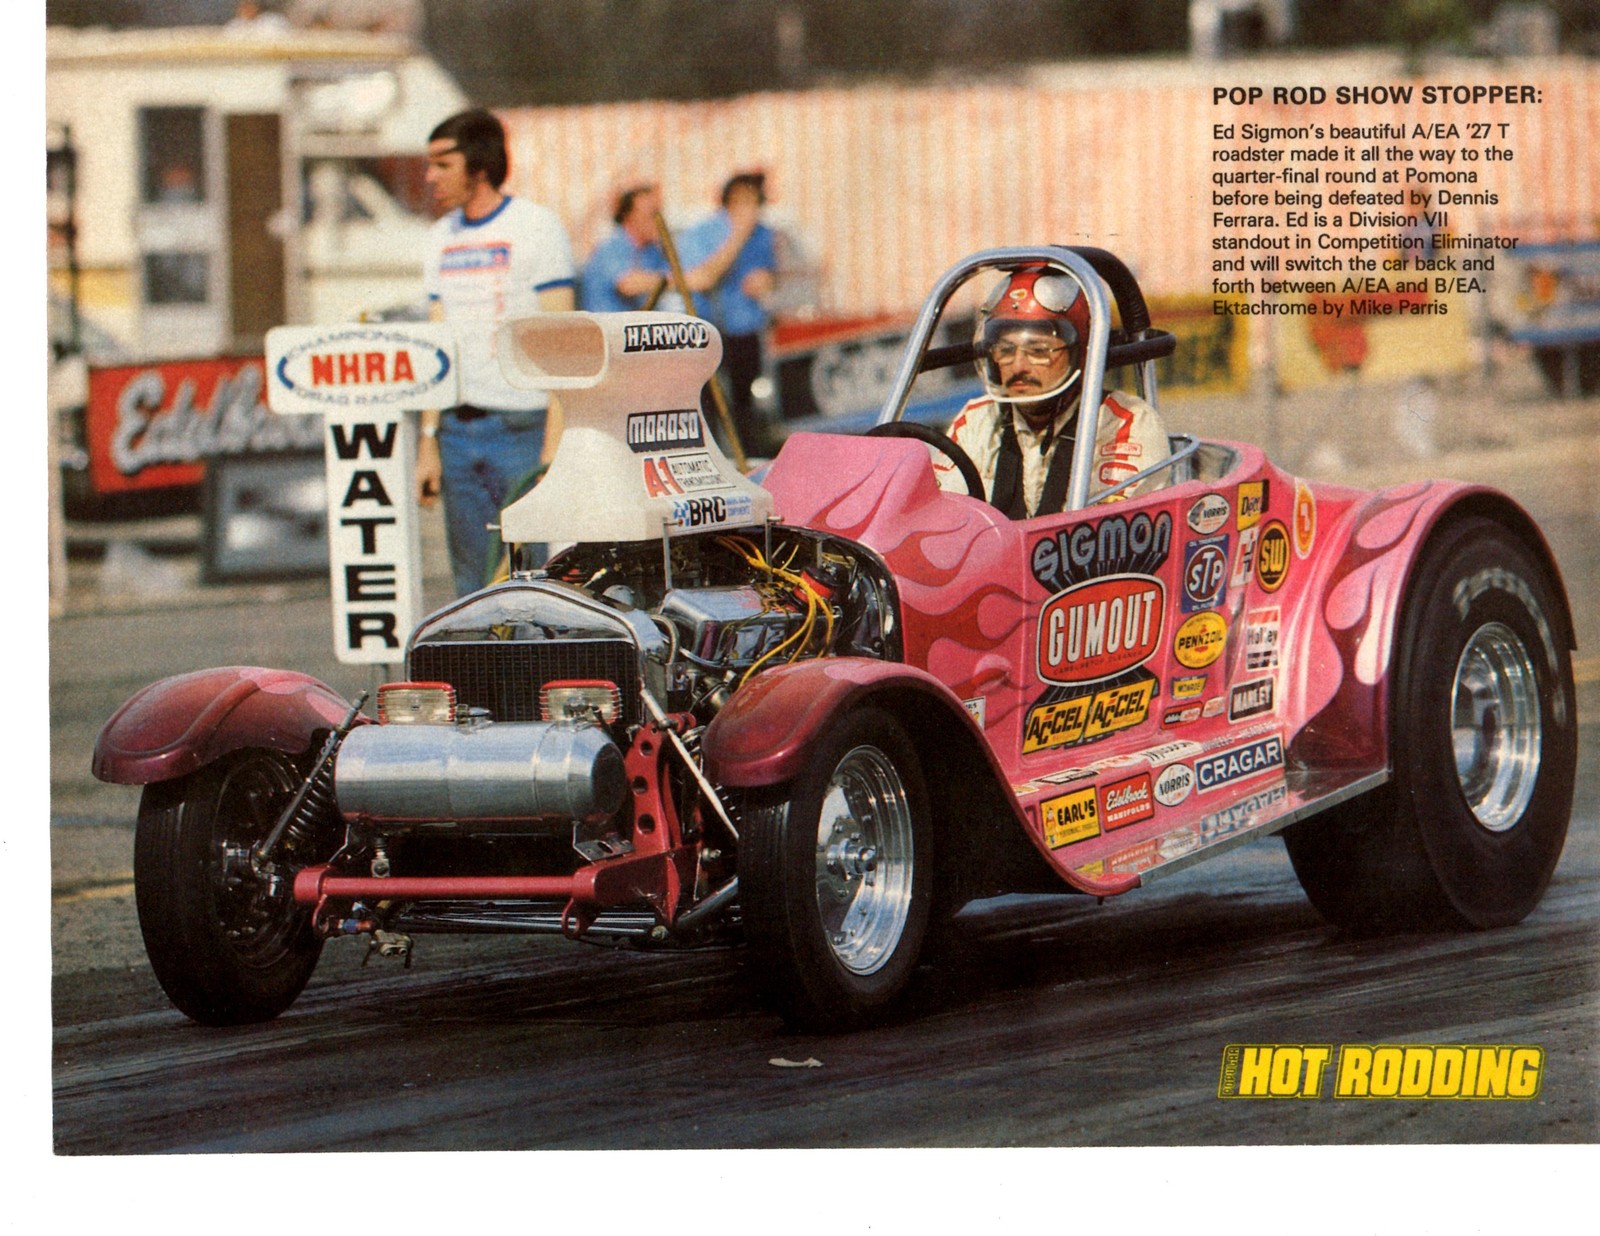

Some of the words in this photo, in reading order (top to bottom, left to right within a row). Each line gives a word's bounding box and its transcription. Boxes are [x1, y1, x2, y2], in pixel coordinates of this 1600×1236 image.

[625, 322, 710, 350] HARWOOD
[311, 350, 415, 387] NHRA
[628, 410, 700, 446] MOROSO
[686, 496, 727, 527] BRC
[330, 422, 400, 649] WATER
[1031, 510, 1172, 581] SIGMON
[1188, 550, 1223, 594] STP
[1260, 538, 1285, 573] SW
[1048, 590, 1156, 667] GUMOUT
[1178, 629, 1223, 650] PENNZOIL
[1027, 706, 1083, 745] ACCEL
[1090, 689, 1145, 729] ACCEL
[1200, 742, 1280, 786] CRAGAR
[1107, 782, 1149, 812] Edelbrock
[1159, 772, 1191, 797] NORRIS
[1057, 798, 1096, 827] EARL'S
[1107, 803, 1151, 823] MANIFOLDS
